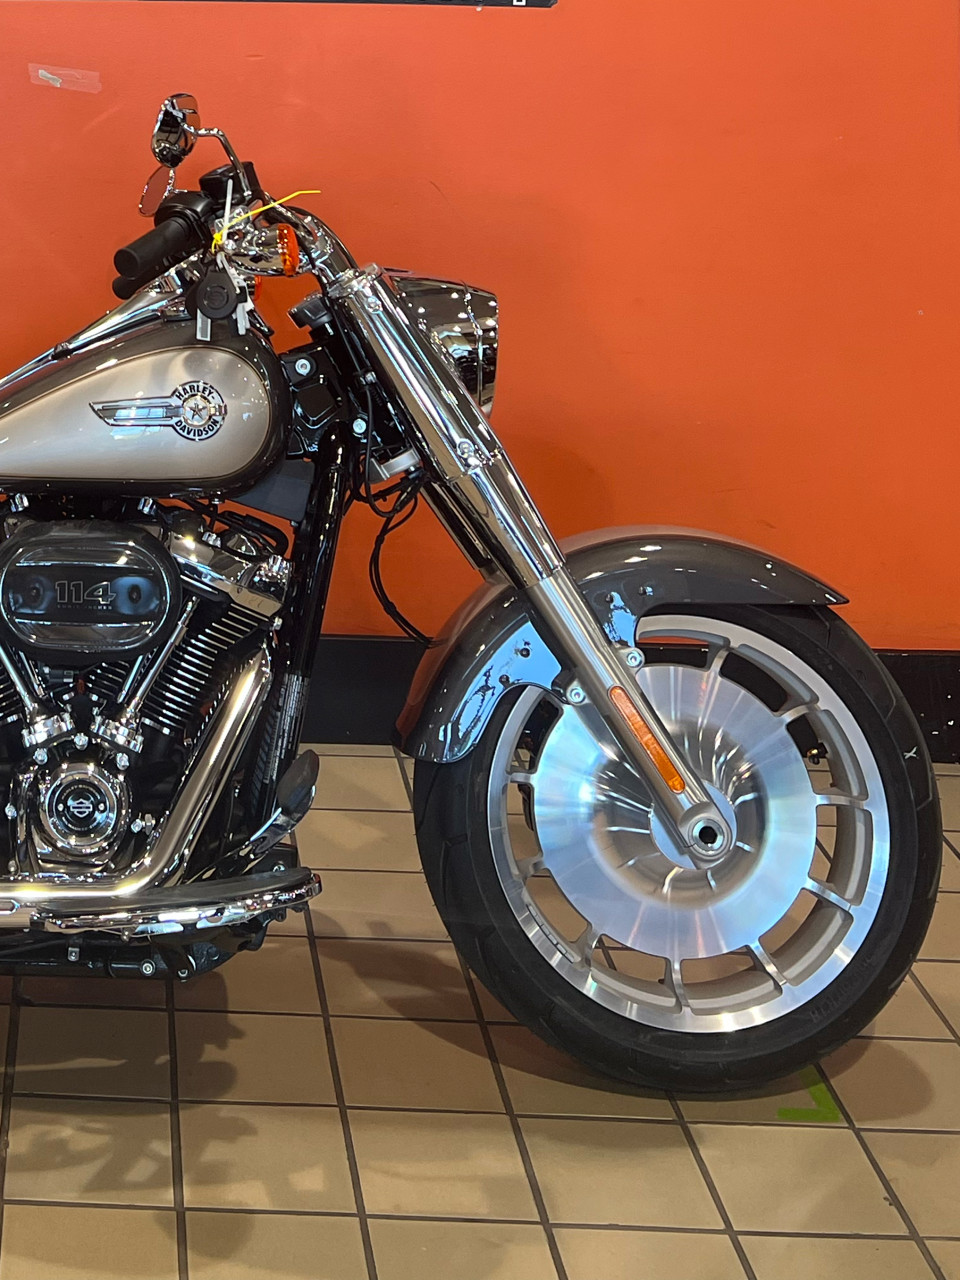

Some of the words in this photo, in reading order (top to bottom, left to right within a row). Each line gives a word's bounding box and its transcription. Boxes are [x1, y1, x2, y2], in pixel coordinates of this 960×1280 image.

[175, 384, 215, 400] HARLEY-
[175, 418, 220, 437] DAVIDSON
[55, 581, 116, 604] 114
